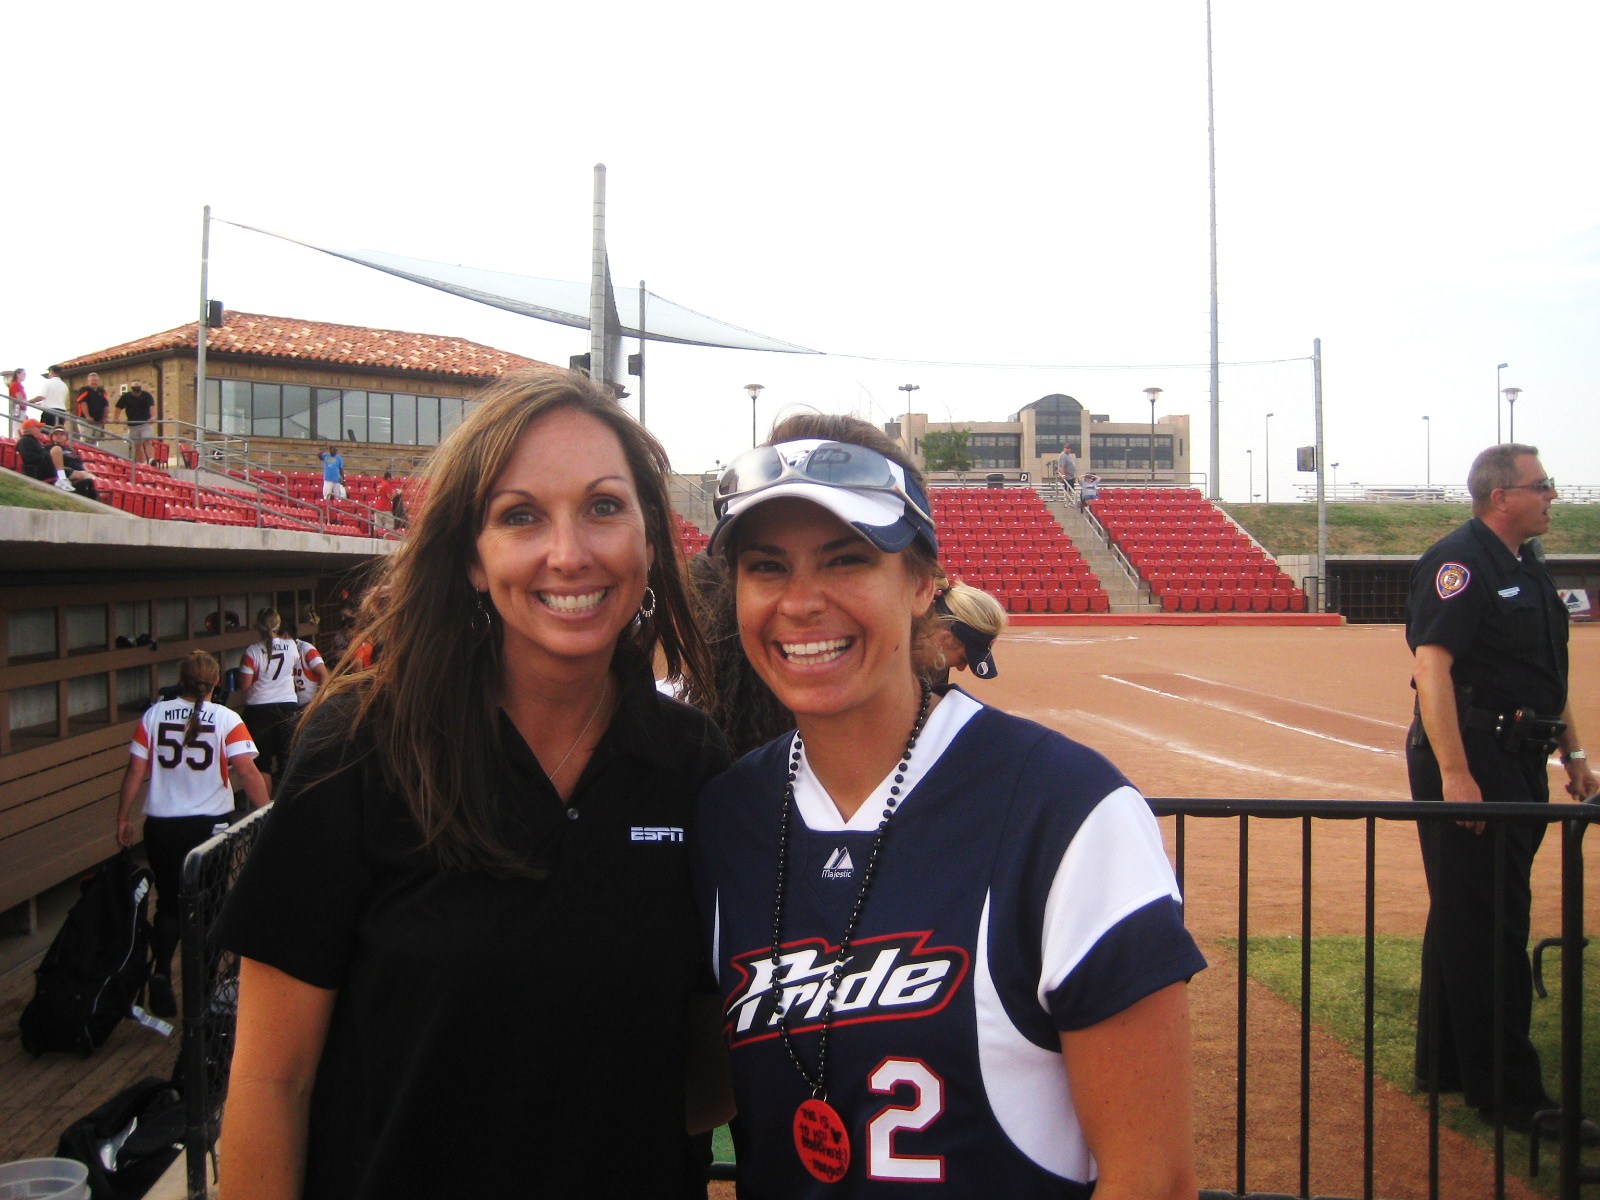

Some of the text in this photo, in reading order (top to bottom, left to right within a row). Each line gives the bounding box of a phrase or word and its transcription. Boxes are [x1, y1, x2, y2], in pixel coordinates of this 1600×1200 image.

[1020, 473, 1028, 482] D
[270, 653, 285, 681] 7
[164, 708, 214, 724] MITCLL
[158, 722, 216, 771] 55
[630, 826, 684, 842] ESPN
[821, 868, 852, 880] Majestic
[726, 947, 951, 1033] Pride
[867, 1055, 946, 1182] 2
